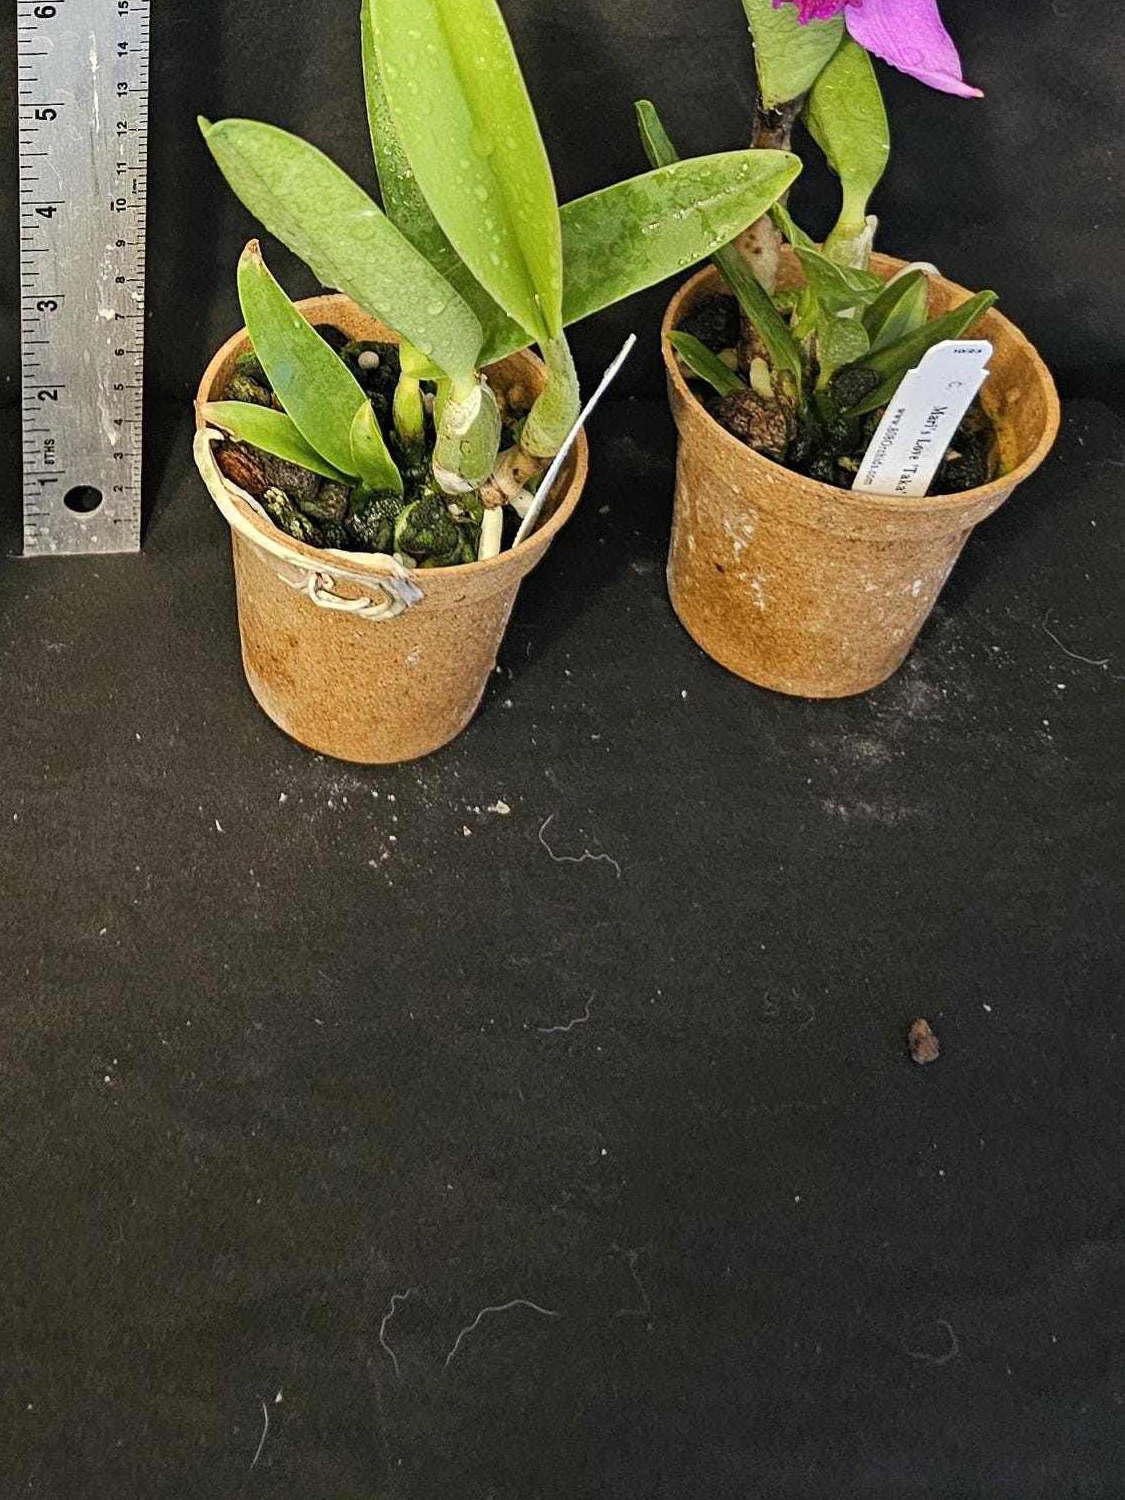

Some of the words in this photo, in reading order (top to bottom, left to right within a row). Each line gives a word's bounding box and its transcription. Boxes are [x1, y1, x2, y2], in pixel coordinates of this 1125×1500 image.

[34, 5, 57, 19] 6
[117, 0, 129, 17] 15
[117, 41, 129, 57] 14
[117, 82, 128, 97] 13
[35, 108, 57, 122] 5
[117, 121, 128, 137] 12
[116, 161, 127, 176] 11
[35, 205, 57, 219] 4
[116, 198, 127, 213] 10
[36, 299, 58, 313] 3
[37, 389, 59, 402] 2
[920, 405, 949, 436] Mari's
[44, 438, 56, 465] 8THS
[908, 438, 932, 461] Love
[38, 478, 59, 487] 1
